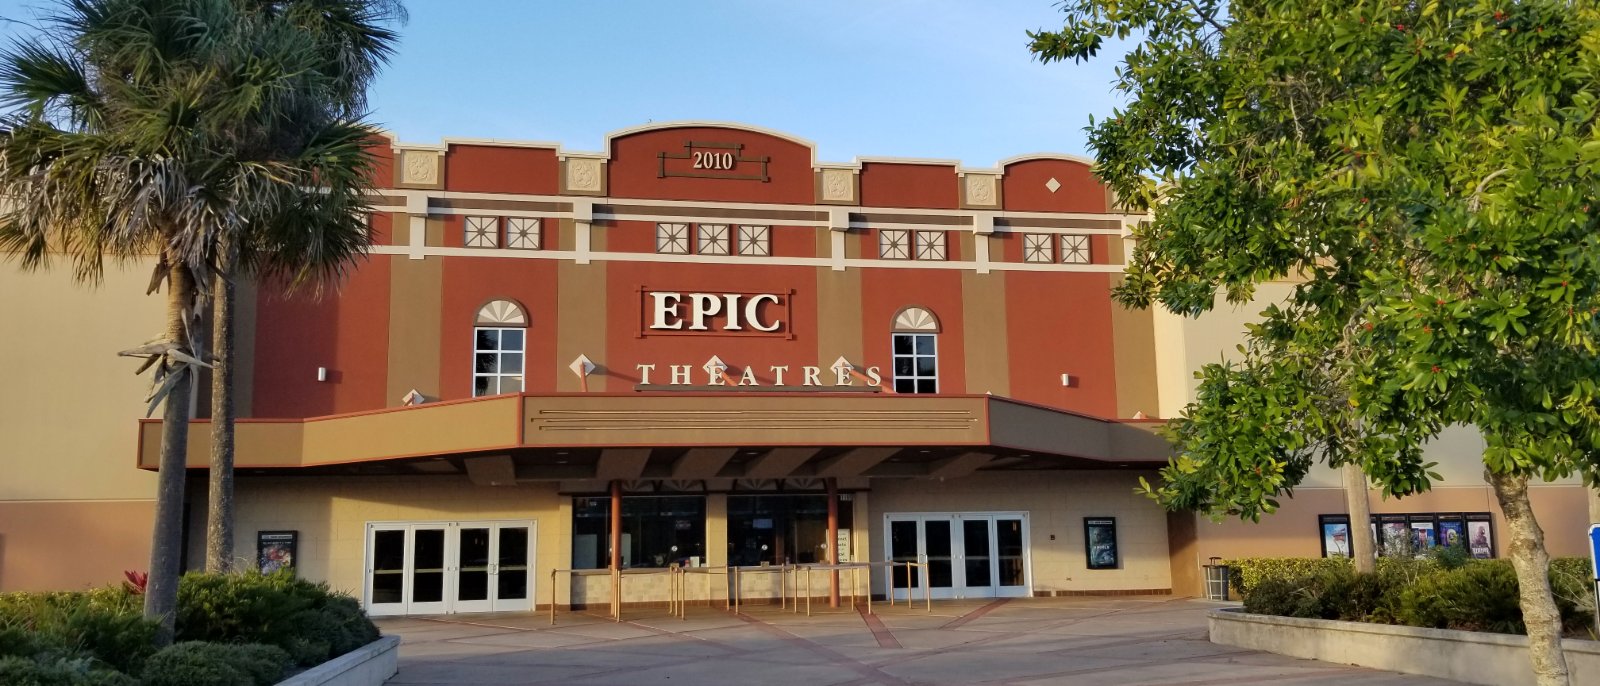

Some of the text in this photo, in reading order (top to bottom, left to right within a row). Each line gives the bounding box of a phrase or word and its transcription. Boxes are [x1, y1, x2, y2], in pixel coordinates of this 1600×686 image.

[693, 151, 733, 170] 2010
[649, 291, 780, 332] EPIC
[636, 363, 882, 387] THEATRES
